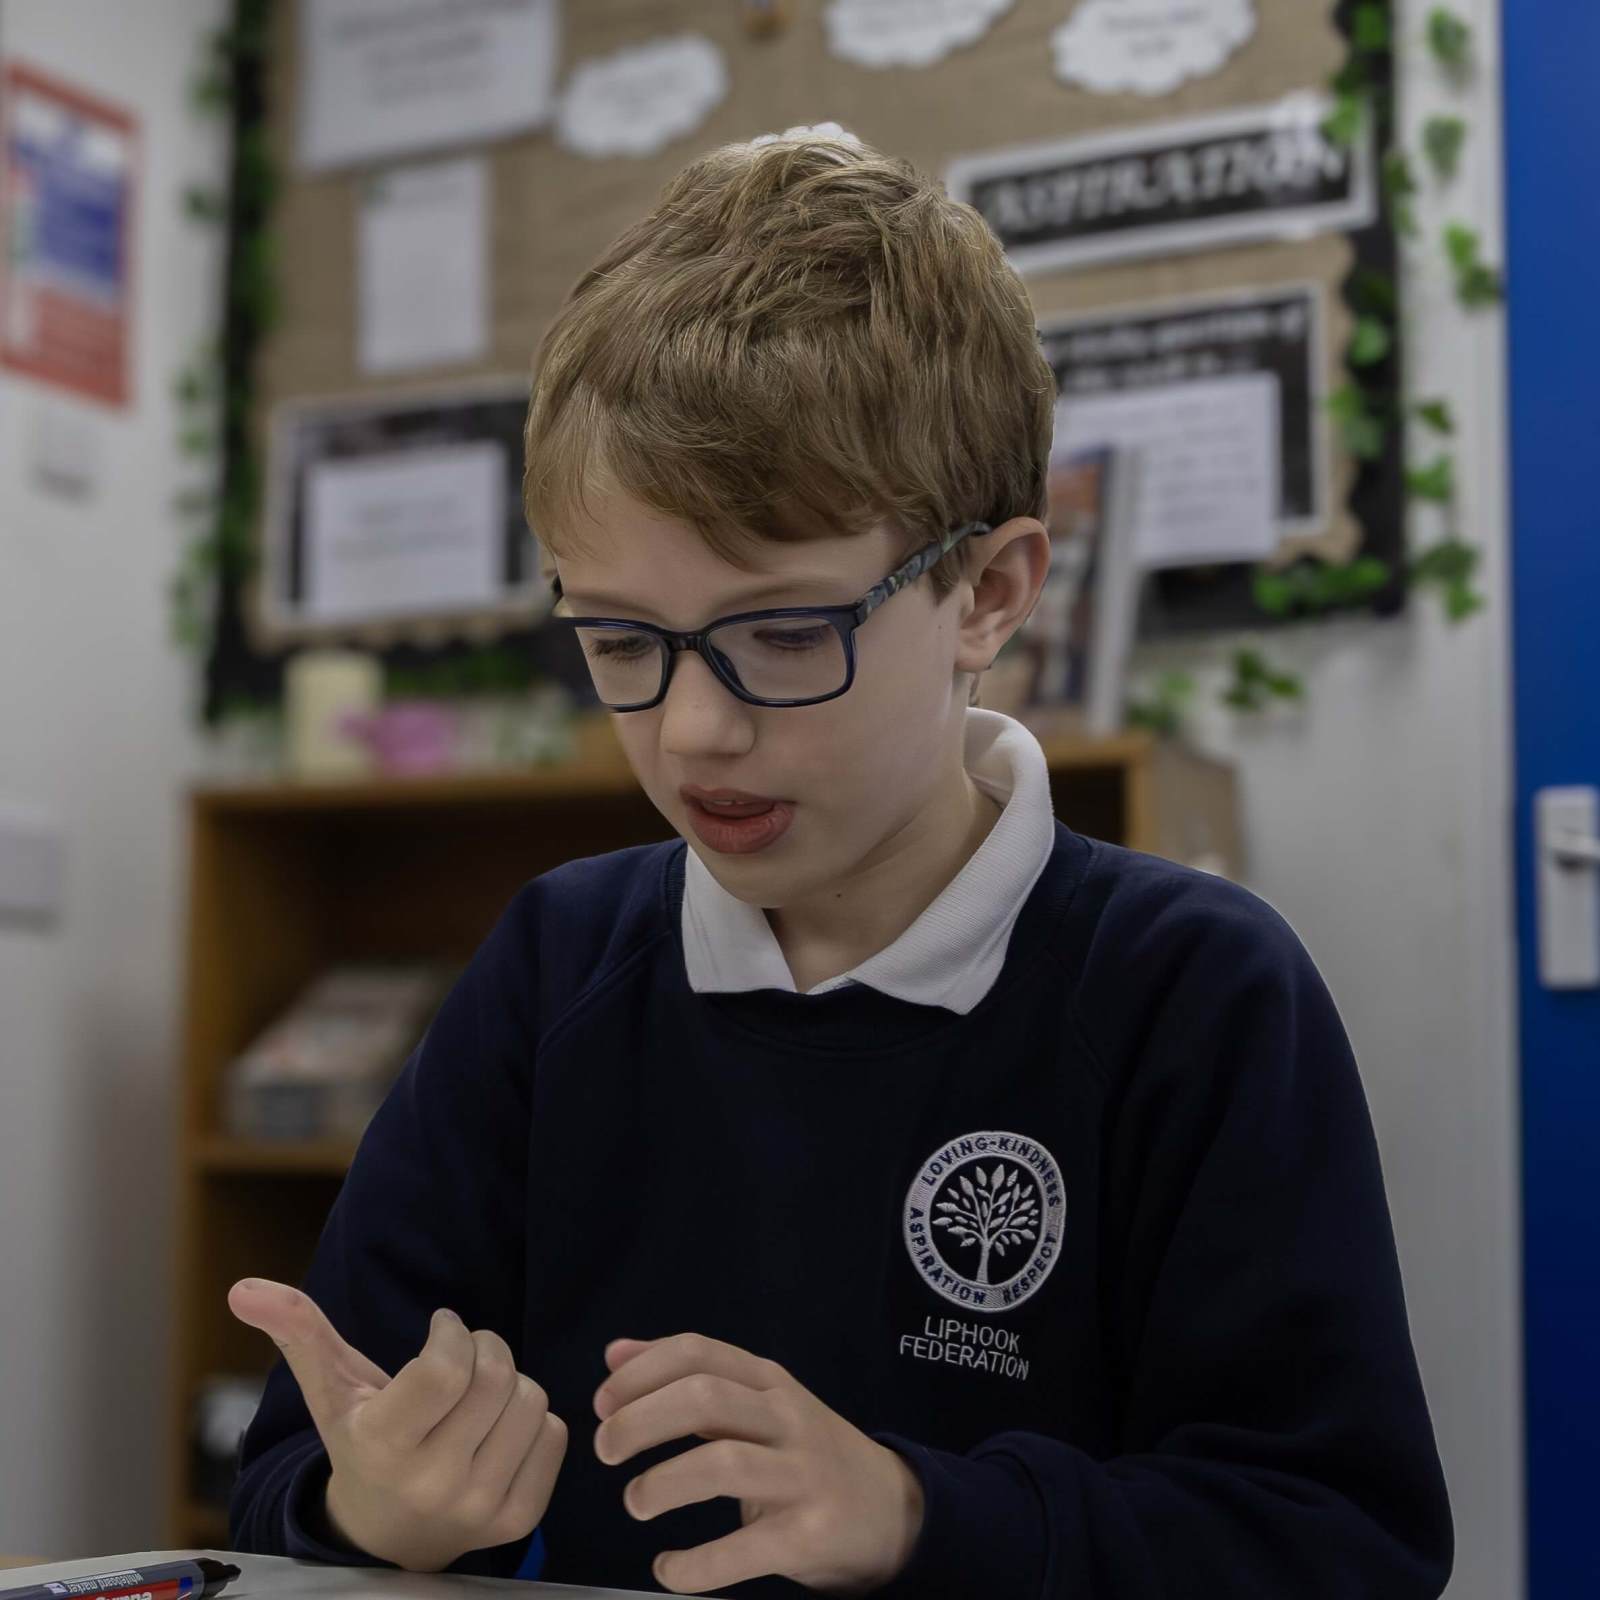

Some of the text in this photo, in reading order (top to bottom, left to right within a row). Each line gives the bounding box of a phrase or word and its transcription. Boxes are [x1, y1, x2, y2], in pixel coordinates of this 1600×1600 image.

[920, 1136, 1060, 1208] LOVING-KINDNESS
[909, 1206, 987, 1305] ASPIRATION
[1002, 1231, 1058, 1304] RESPECT
[899, 1334, 1030, 1381] FEDERATION
[924, 1316, 1020, 1354] LIPHOOK
[67, 1573, 144, 1594] whiteboard marker
